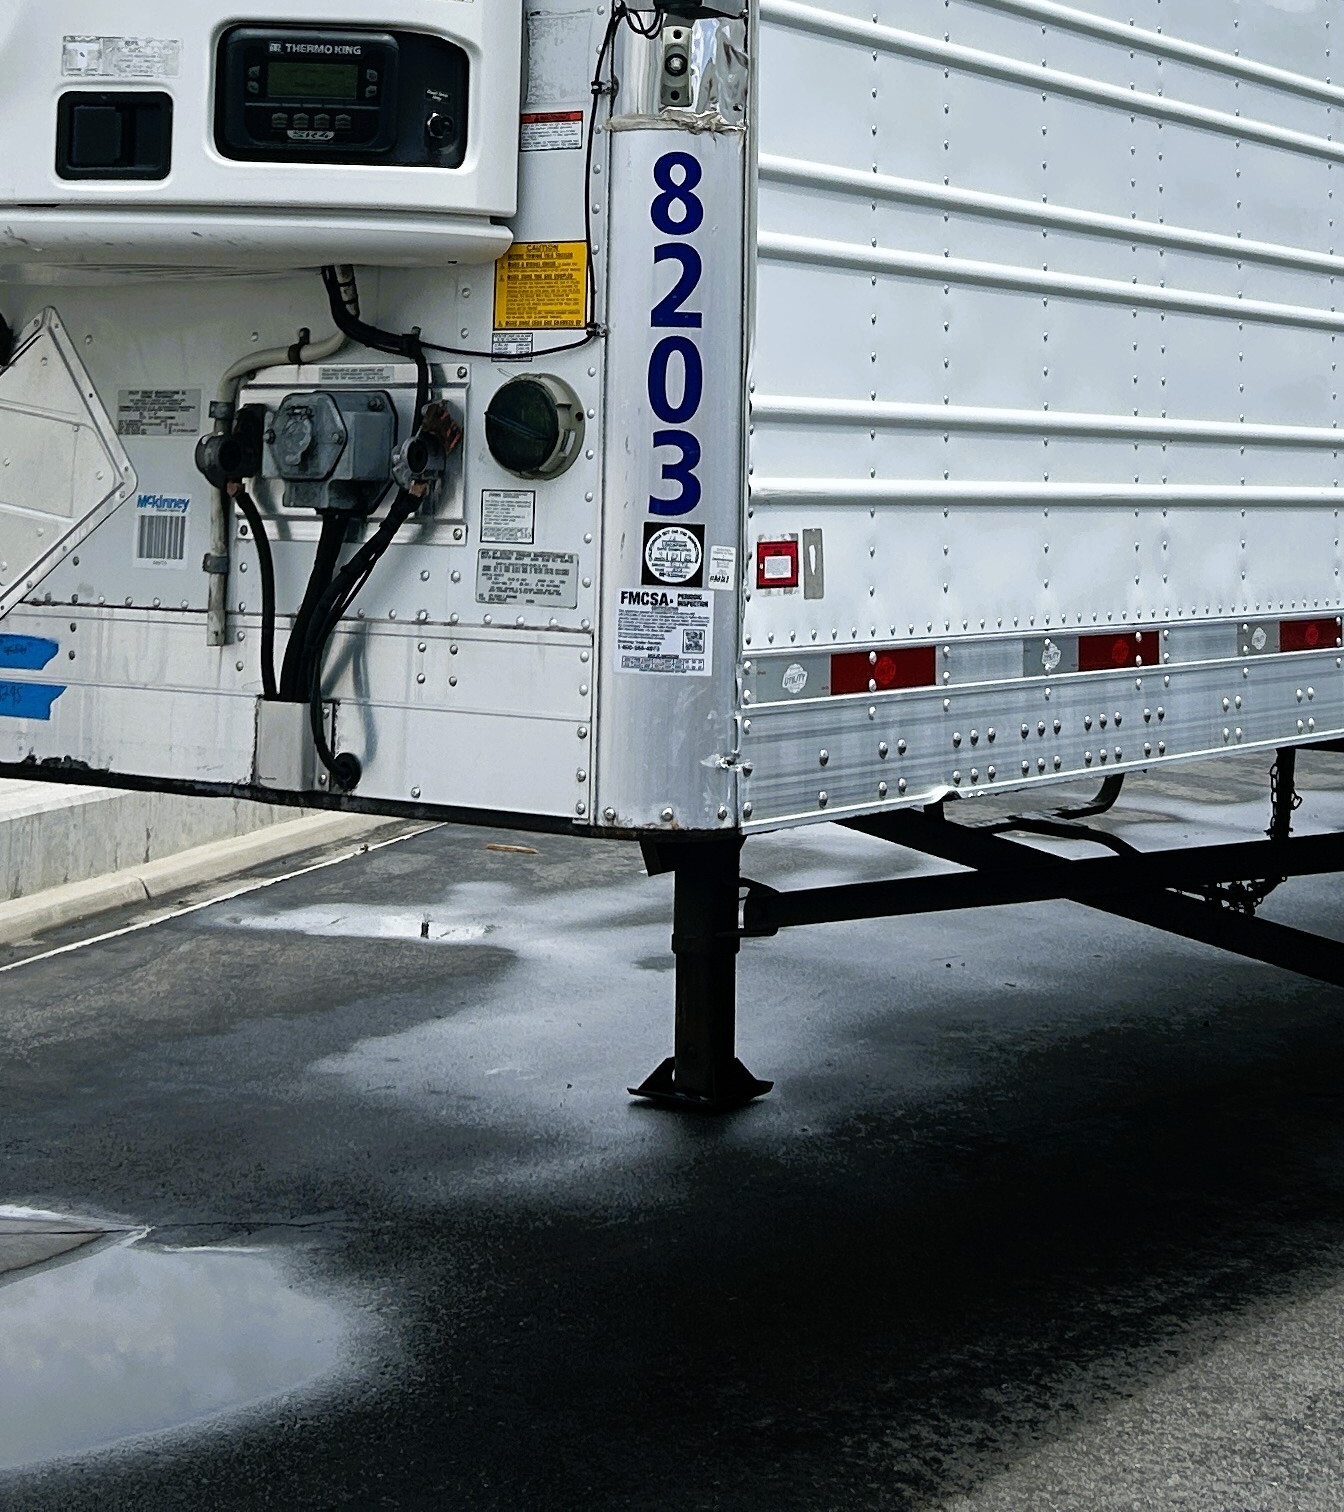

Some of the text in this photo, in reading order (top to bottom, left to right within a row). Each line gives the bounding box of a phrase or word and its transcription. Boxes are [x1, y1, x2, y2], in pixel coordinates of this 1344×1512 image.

[286, 43, 332, 54] THERMO
[335, 45, 361, 55] KING
[648, 151, 703, 517] 8203
[784, 673, 806, 687] UTILITY
